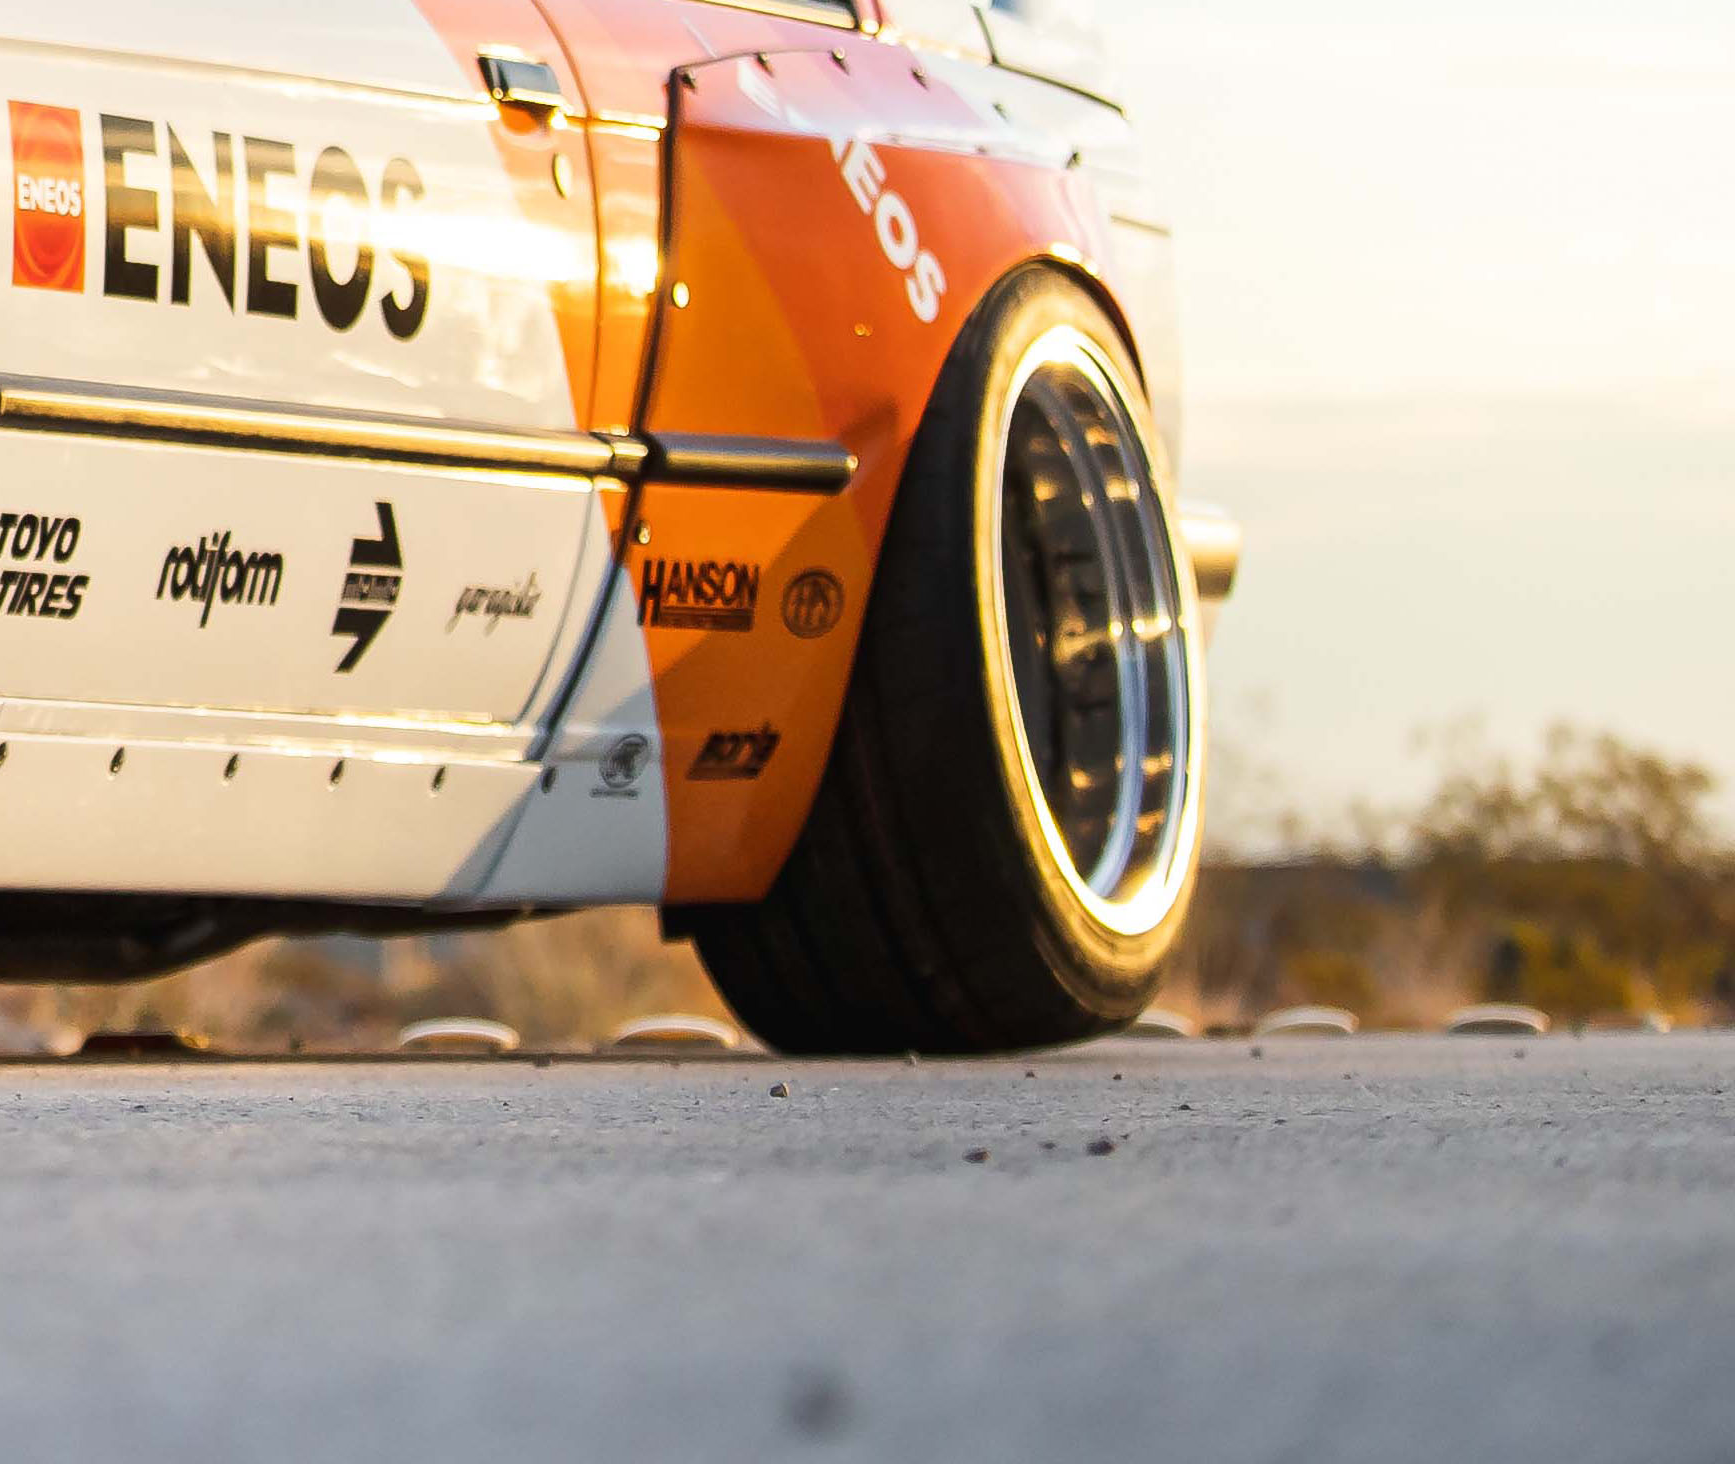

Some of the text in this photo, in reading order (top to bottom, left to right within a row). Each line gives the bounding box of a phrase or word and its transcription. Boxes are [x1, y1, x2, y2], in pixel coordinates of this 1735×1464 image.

[17, 173, 82, 218] ENEOS
[100, 113, 430, 342] ENEOS
[155, 529, 283, 629] rotiform
[637, 559, 760, 627] HANSON
